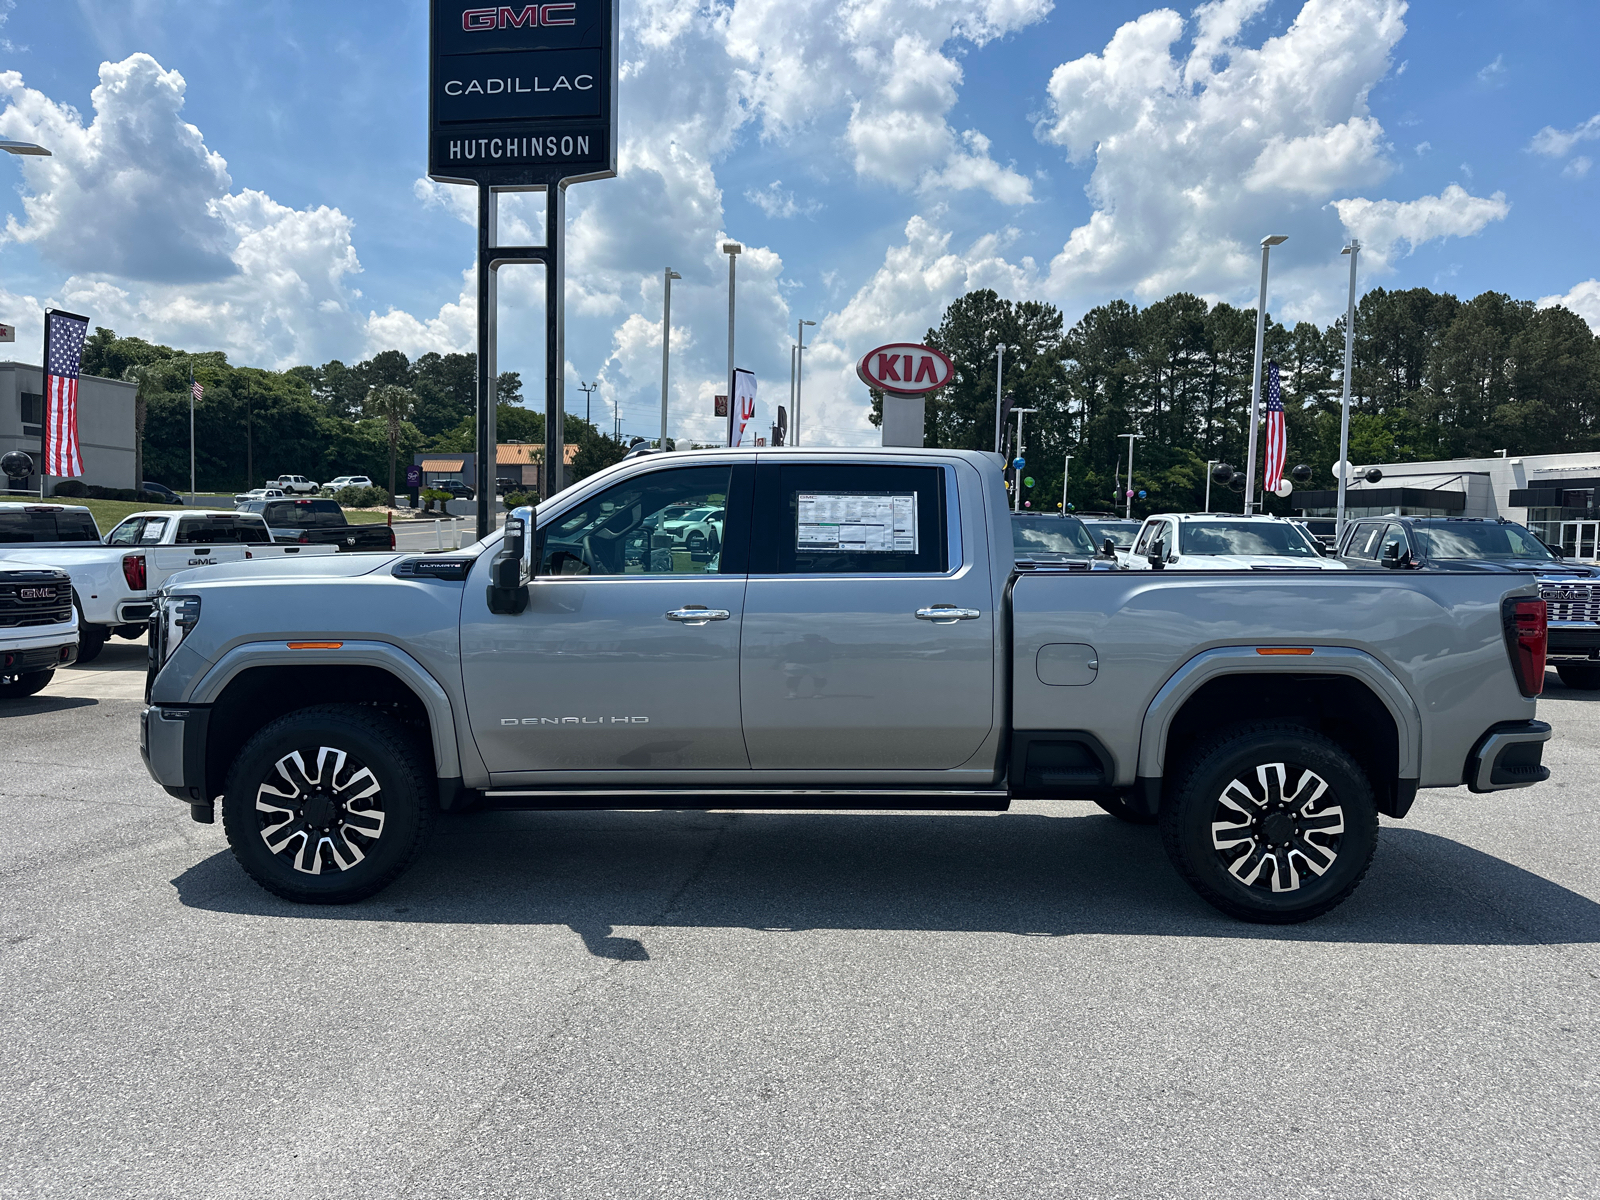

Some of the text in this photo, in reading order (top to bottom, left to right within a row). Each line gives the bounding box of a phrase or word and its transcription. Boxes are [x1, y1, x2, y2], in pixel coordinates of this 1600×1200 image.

[462, 2, 576, 32] GMC
[444, 74, 593, 96] CADILLAC
[450, 135, 589, 159] HUTCHINSON
[878, 353, 939, 384] KIA
[188, 558, 217, 566] GMC
[20, 587, 57, 599] GMC
[1542, 590, 1589, 600] GMC
[500, 716, 650, 726] DENALI HD
